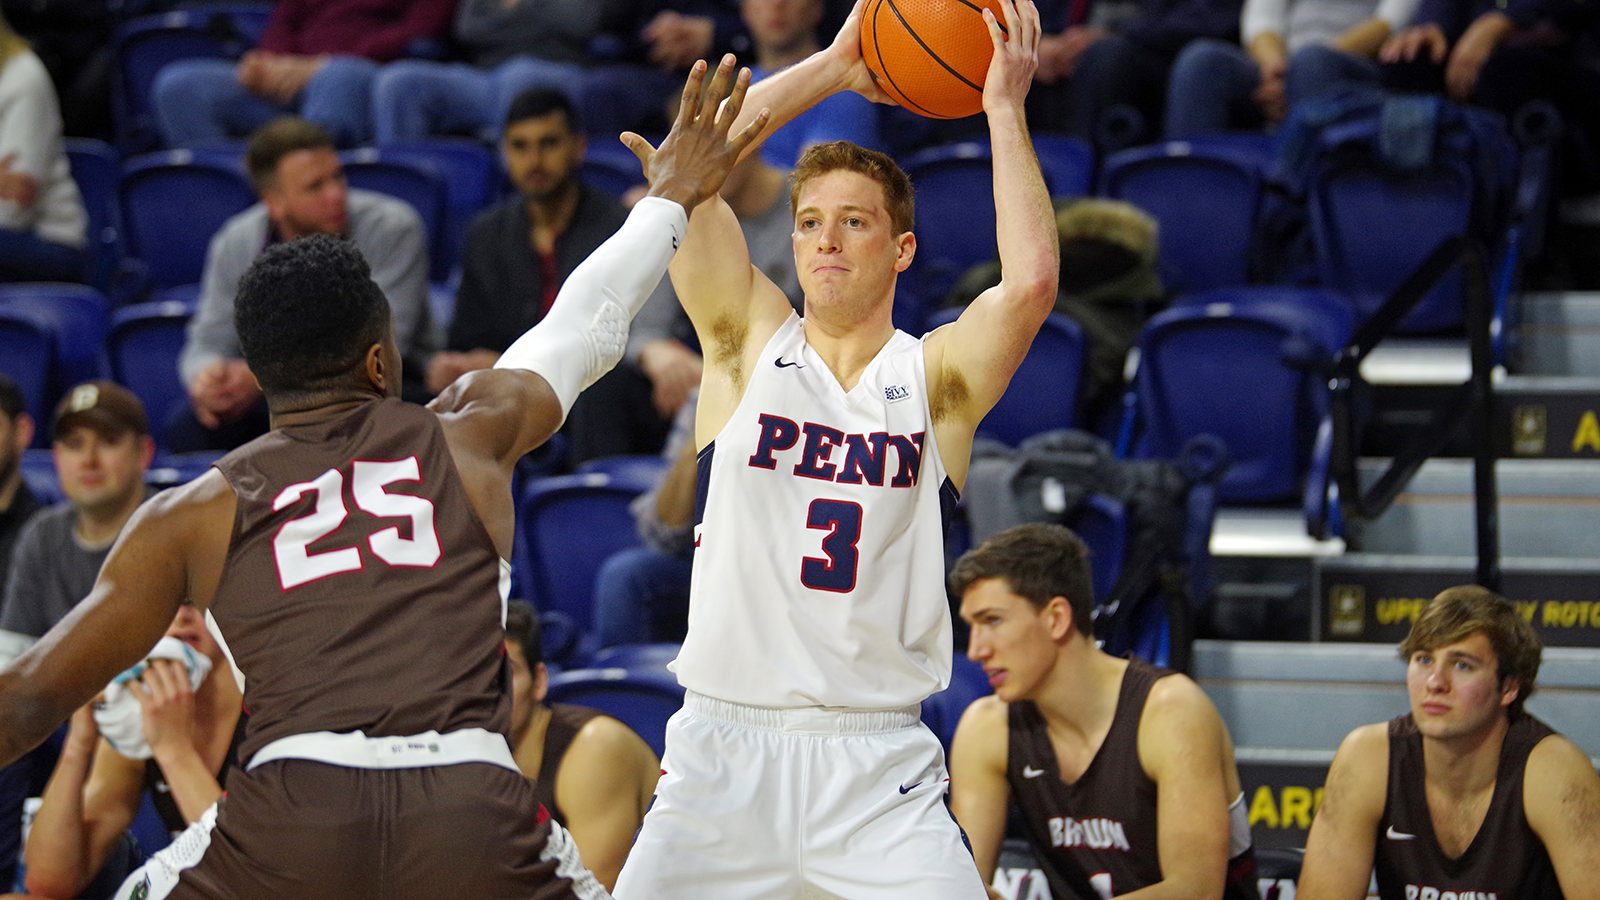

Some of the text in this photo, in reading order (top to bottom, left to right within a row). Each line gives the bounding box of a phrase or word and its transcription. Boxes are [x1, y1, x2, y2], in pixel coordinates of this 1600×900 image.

[891, 386, 908, 396] IVY
[748, 413, 926, 488] PENN
[271, 454, 444, 593] 25
[800, 498, 863, 593] 3
